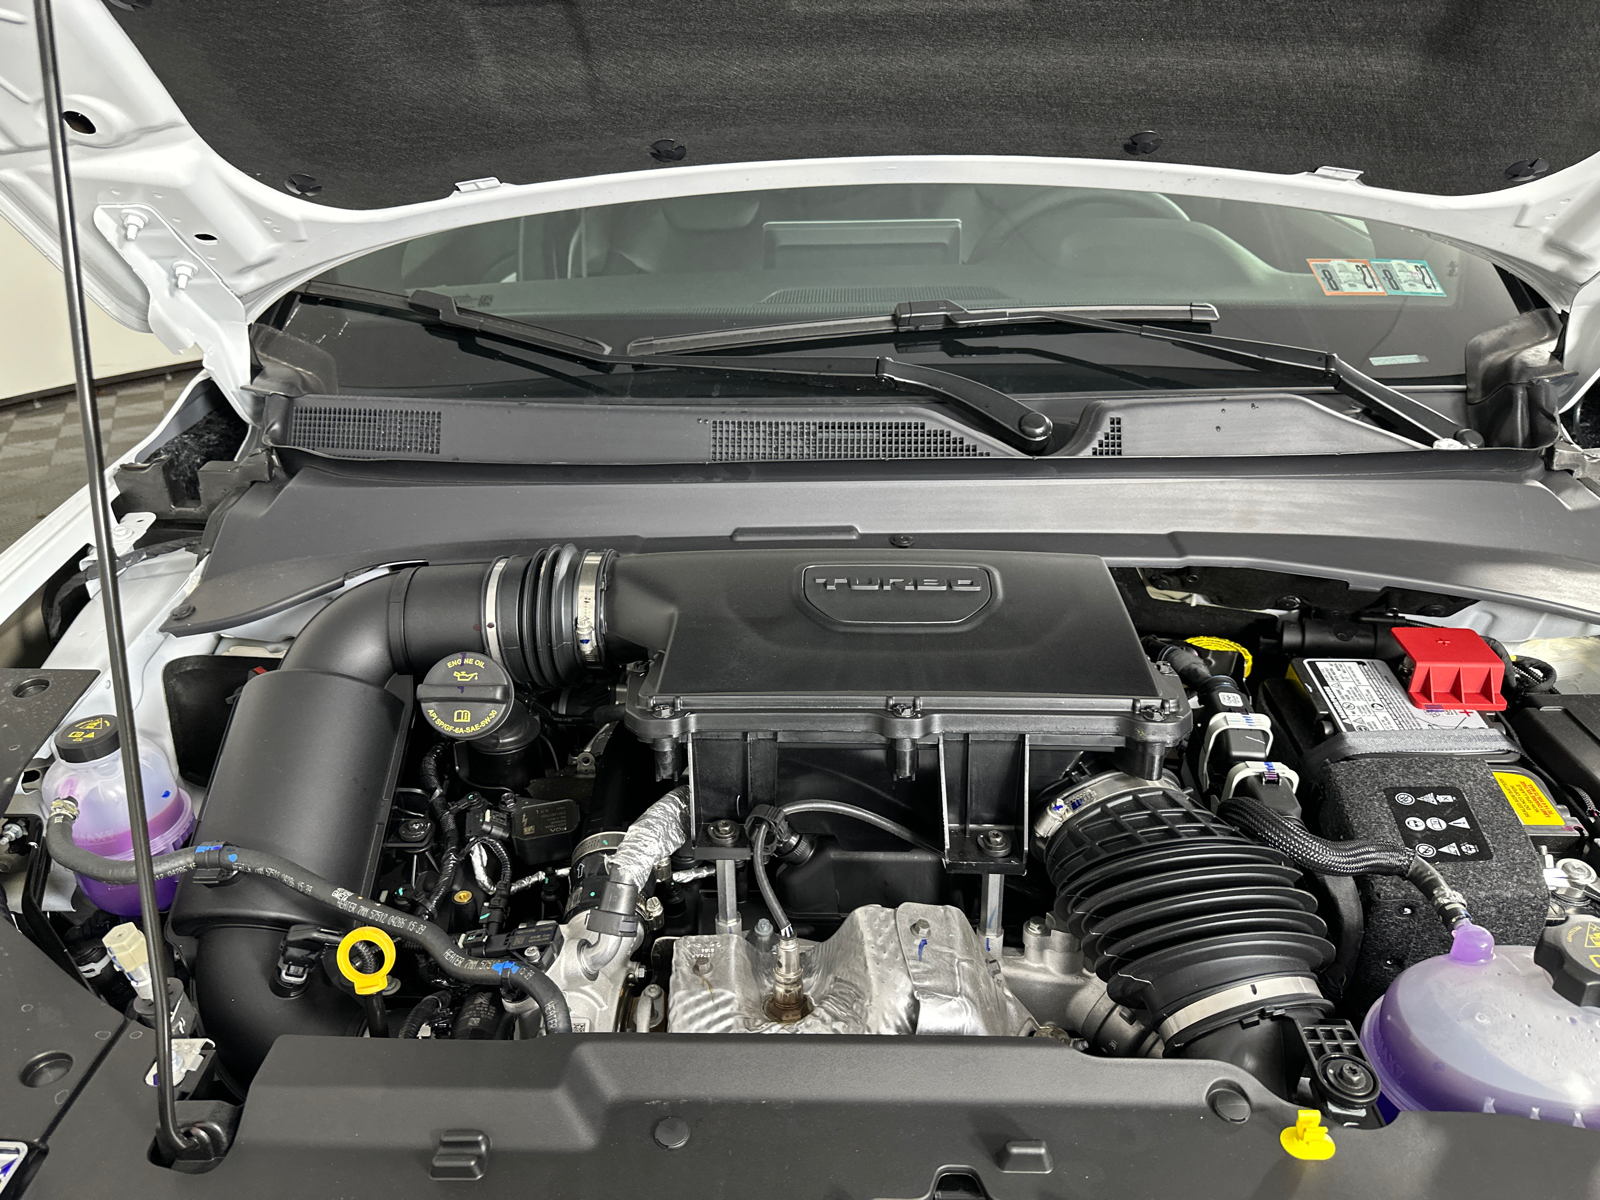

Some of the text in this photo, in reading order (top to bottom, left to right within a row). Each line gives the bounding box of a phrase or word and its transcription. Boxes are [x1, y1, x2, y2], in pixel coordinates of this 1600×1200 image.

[1321, 264, 1379, 291] 8 27
[1382, 264, 1437, 291] 8 27
[814, 577, 982, 592] TURBO
[446, 657, 485, 669] ENGNE OIL
[427, 709, 438, 721] API
[336, 899, 358, 914] HEATER
[369, 909, 389, 924] 57512
[407, 920, 427, 935] 15:39
[442, 948, 466, 968] HEATER
[544, 1000, 559, 1030] HEATER
